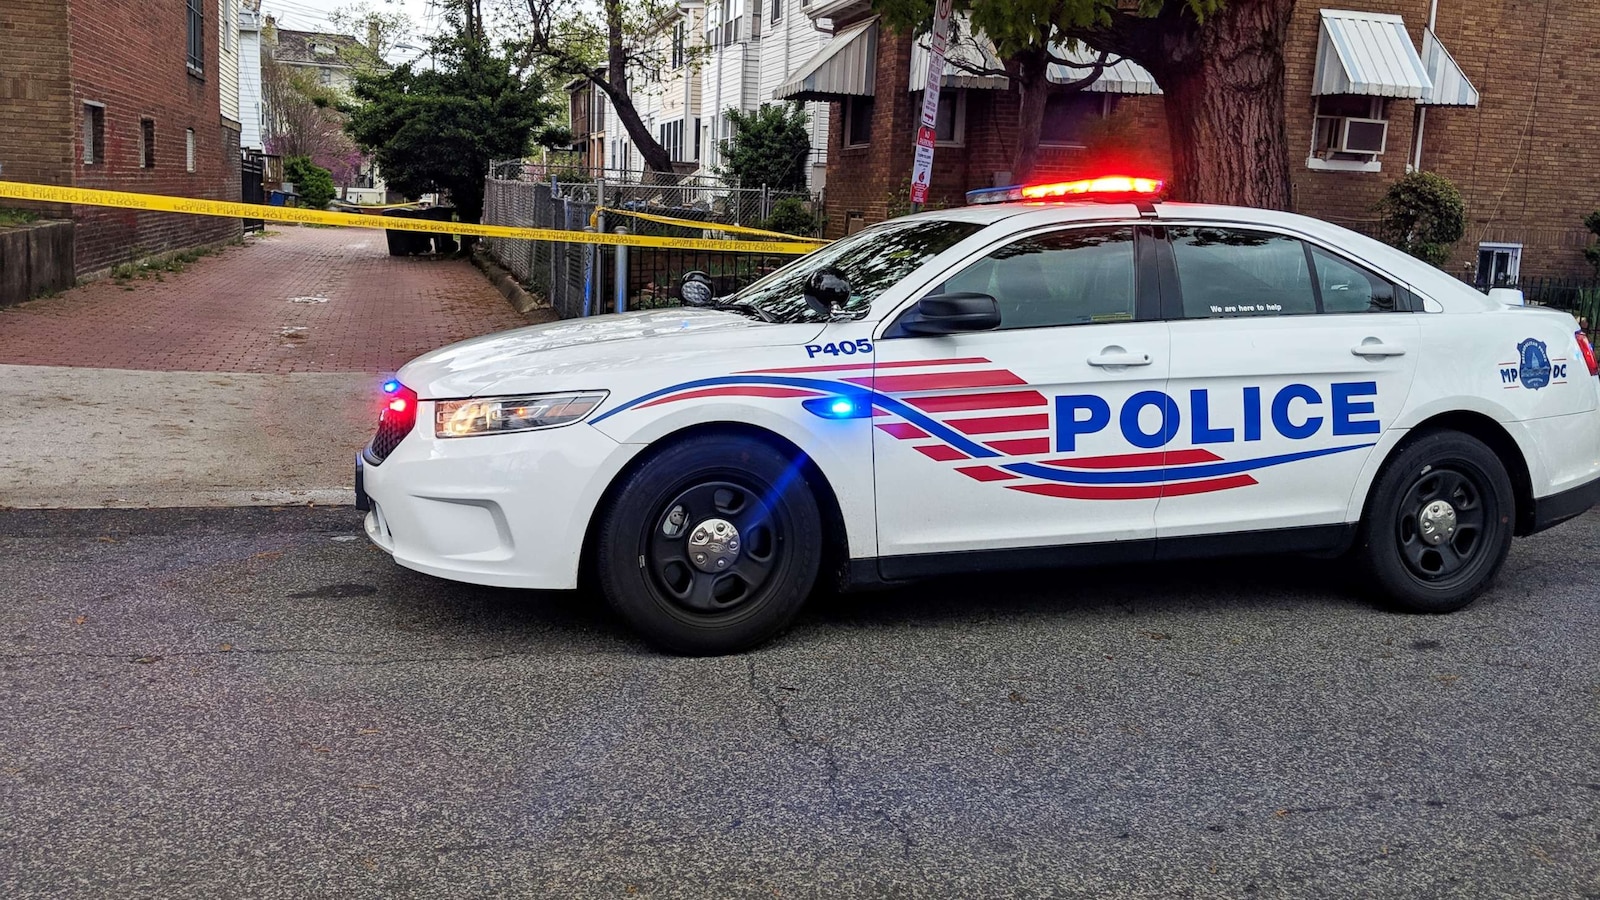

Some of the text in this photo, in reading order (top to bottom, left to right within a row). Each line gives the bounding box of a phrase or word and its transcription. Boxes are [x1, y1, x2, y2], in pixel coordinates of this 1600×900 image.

[1210, 305, 1222, 313] We
[1266, 303, 1281, 312] help
[804, 338, 873, 358] P405
[1500, 368, 1518, 383] MP
[1553, 364, 1567, 378] DC
[1055, 381, 1381, 452] POLICE
